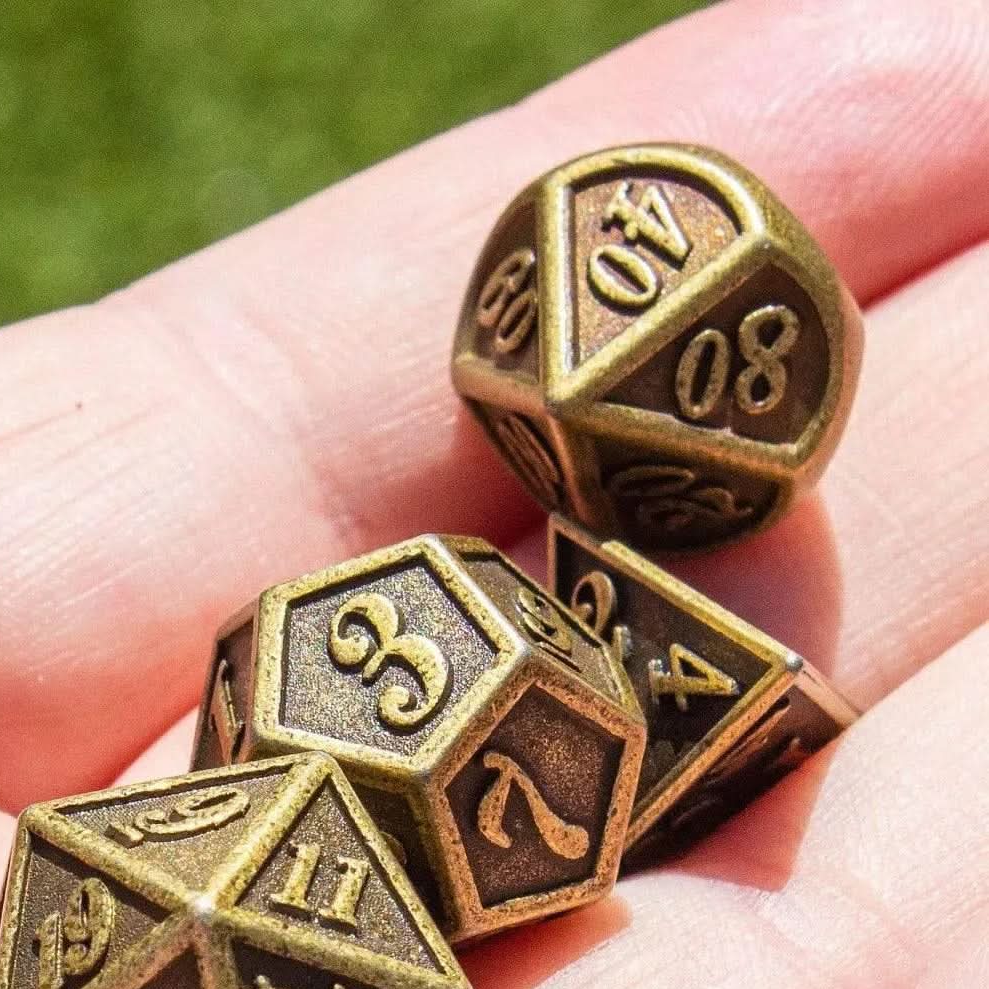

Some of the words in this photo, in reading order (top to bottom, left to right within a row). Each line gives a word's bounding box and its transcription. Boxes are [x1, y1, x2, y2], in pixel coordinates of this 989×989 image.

[586, 181, 694, 309] 40
[674, 304, 800, 420] 80
[329, 591, 450, 728] 3
[648, 642, 740, 712] 4
[268, 839, 371, 930] 11
